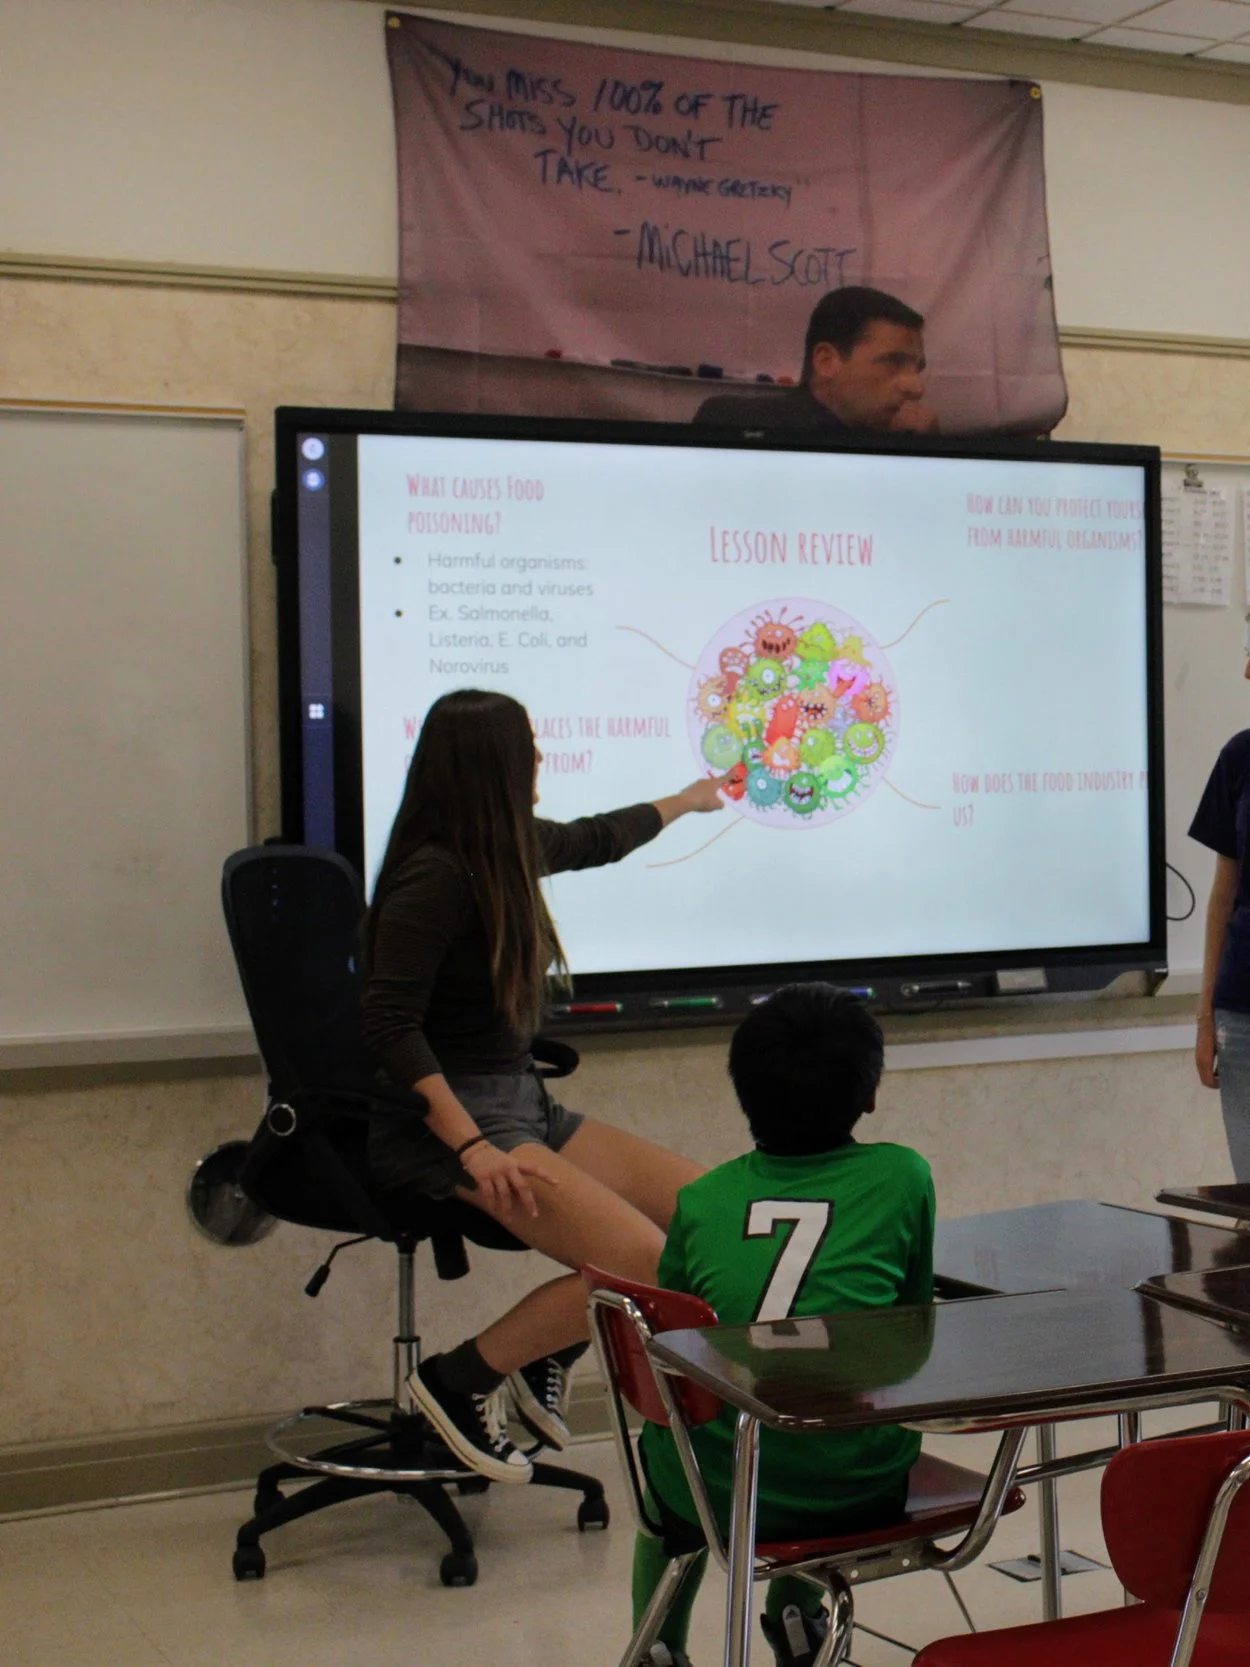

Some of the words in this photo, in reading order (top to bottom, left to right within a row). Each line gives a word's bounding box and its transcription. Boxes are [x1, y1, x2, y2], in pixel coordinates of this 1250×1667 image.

[507, 69, 577, 107] MISS
[593, 78, 665, 115] 100%
[674, 93, 715, 120] OF
[721, 94, 780, 130] THE
[460, 98, 547, 135] SHOTS
[557, 116, 615, 156] YOU
[622, 124, 724, 161] DON'T
[768, 240, 856, 287] SCOTT
[406, 473, 447, 497] WHAT
[452, 476, 501, 501] CAUSES
[507, 475, 545, 501] FOOD
[966, 493, 994, 515] HOW
[999, 495, 1023, 515] CAN
[1027, 497, 1050, 517] YOU
[1056, 497, 1101, 518] PROTECT
[407, 510, 502, 535] POISONING?
[709, 525, 787, 565] LESSON
[798, 532, 874, 567] REVIEW
[967, 527, 1002, 548] FROM
[1006, 527, 1063, 549] HARMFUL
[427, 553, 496, 568] Harmful
[427, 579, 496, 596] bacteria
[501, 580, 533, 596] and
[537, 581, 595, 596] viruses
[556, 632, 588, 648] and
[429, 658, 510, 675] Norovirus
[529, 716, 573, 740] LACES
[578, 717, 601, 739] THE
[607, 716, 672, 738] HARMFUL
[545, 748, 593, 774] FROM?
[952, 771, 979, 794] HOW
[984, 773, 1014, 793] DOES
[1017, 772, 1038, 792] THE
[1043, 771, 1073, 792] FOOD
[1077, 770, 1135, 791] INDUSTRY
[953, 804, 974, 827] US?
[743, 1197, 834, 1325] 7
